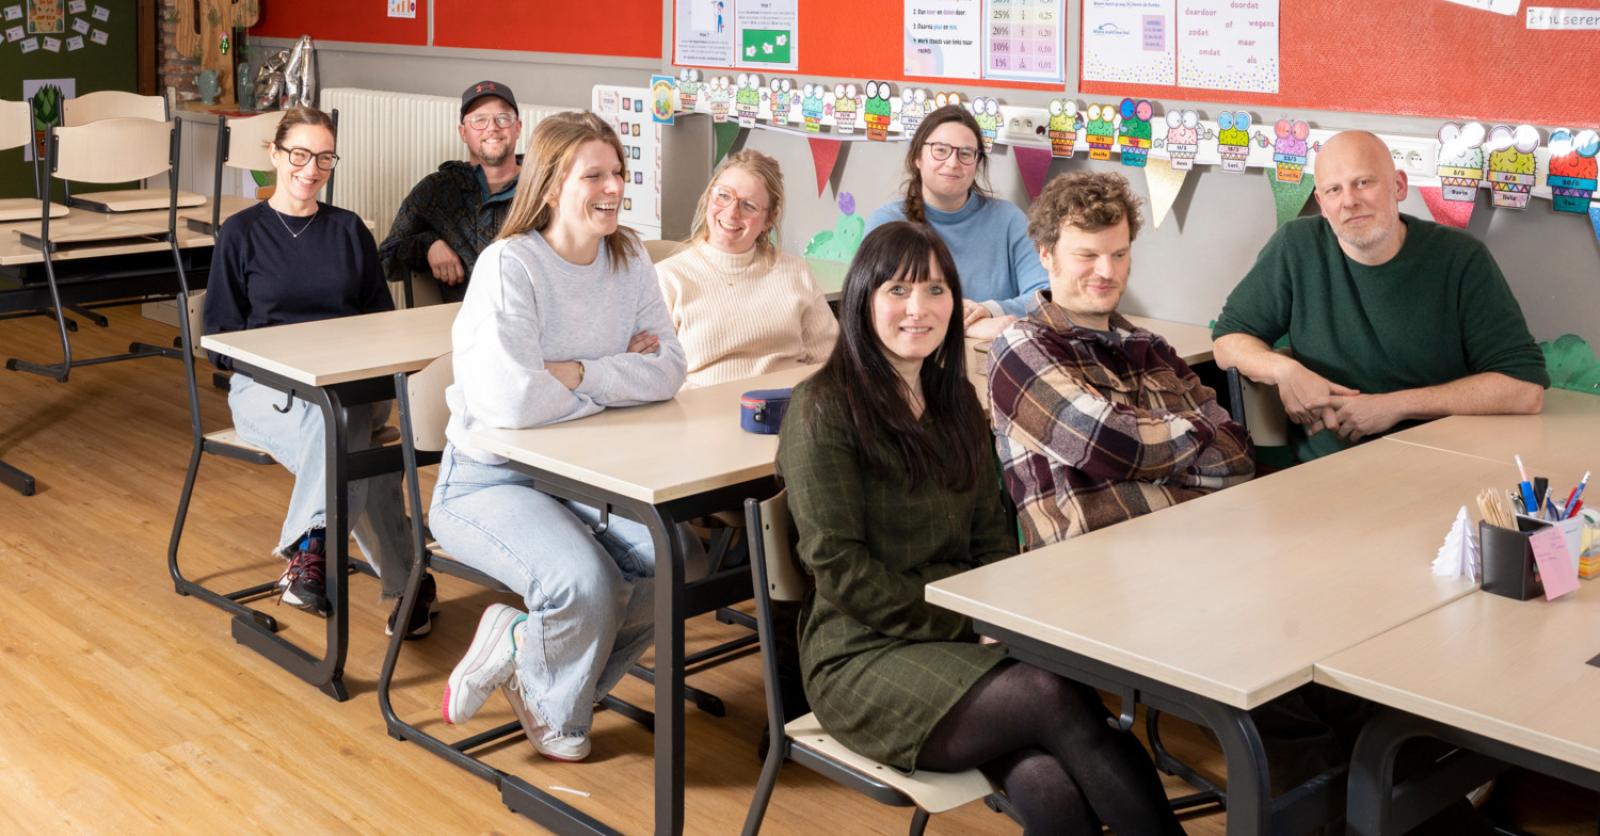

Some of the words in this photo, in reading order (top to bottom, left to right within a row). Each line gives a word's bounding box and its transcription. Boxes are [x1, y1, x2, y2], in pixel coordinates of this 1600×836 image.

[1230, 0, 1259, 9] doordat
[993, 10, 1009, 19] 25%
[1185, 8, 1216, 16] daardoor
[1249, 20, 1274, 29] wegens
[992, 26, 1008, 35] 20%
[993, 42, 1008, 51] 10%
[1199, 48, 1221, 56] omdat
[995, 58, 1006, 67] 1%
[1247, 56, 1257, 64] als
